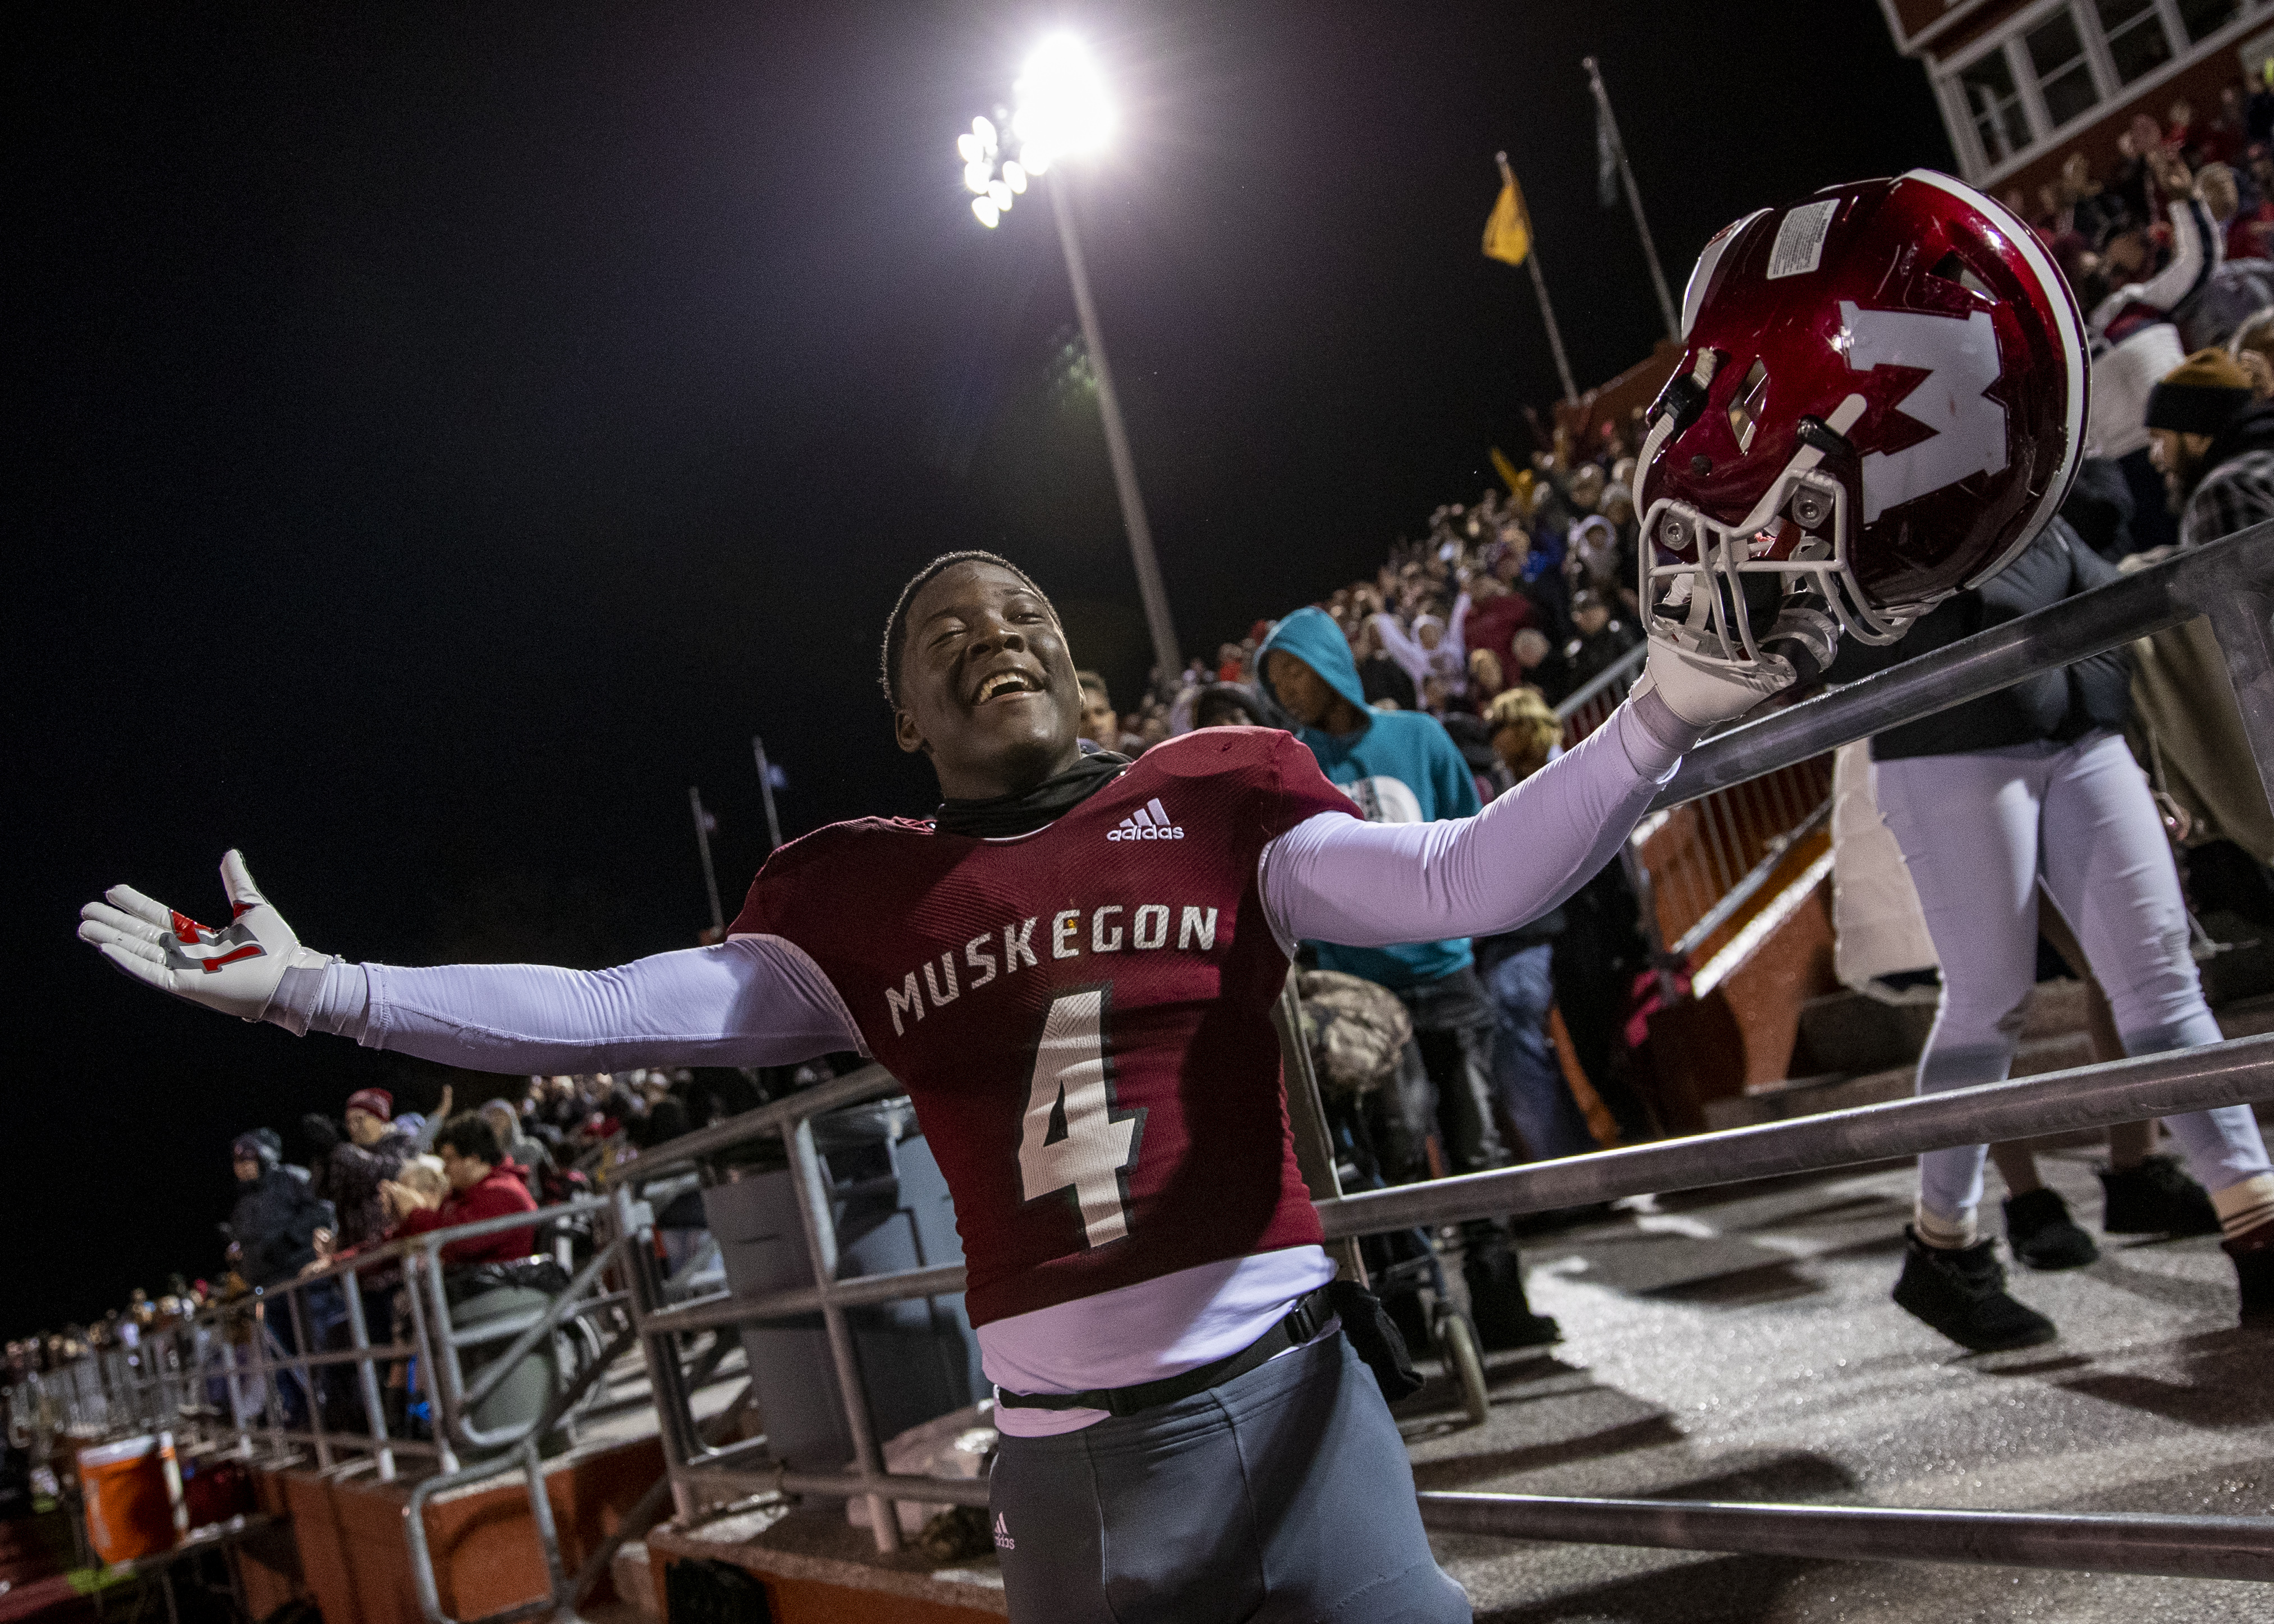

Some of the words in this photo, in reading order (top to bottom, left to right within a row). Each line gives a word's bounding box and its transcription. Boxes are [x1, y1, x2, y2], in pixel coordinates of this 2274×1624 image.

[1839, 300, 2007, 525] M
[1106, 824, 1185, 842] adidas
[884, 904, 1218, 1037] MUSKEGON
[1018, 989, 1138, 1249] 4
